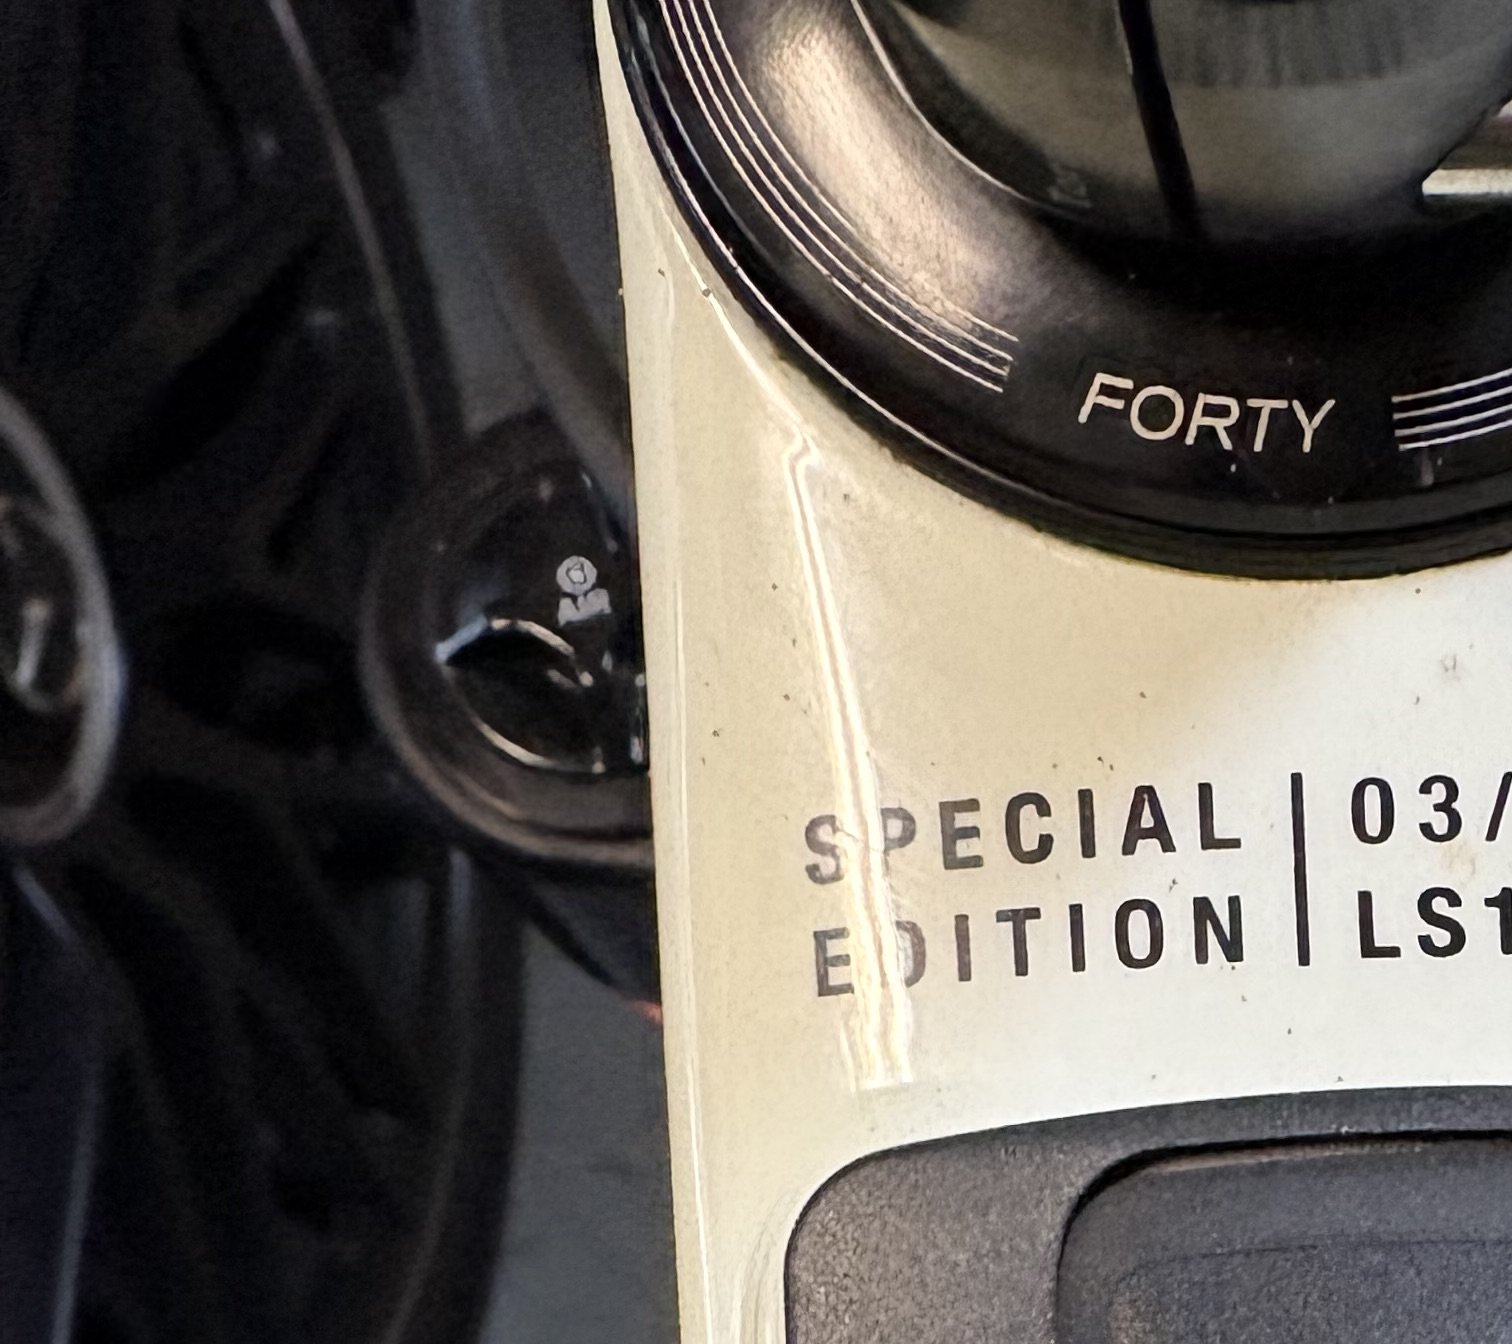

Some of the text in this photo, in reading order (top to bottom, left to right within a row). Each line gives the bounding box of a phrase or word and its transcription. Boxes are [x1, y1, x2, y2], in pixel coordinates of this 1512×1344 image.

[1077, 372, 1336, 453] FORTY
[803, 781, 1242, 885] SPECIAL
[812, 894, 1244, 998] EDITION
